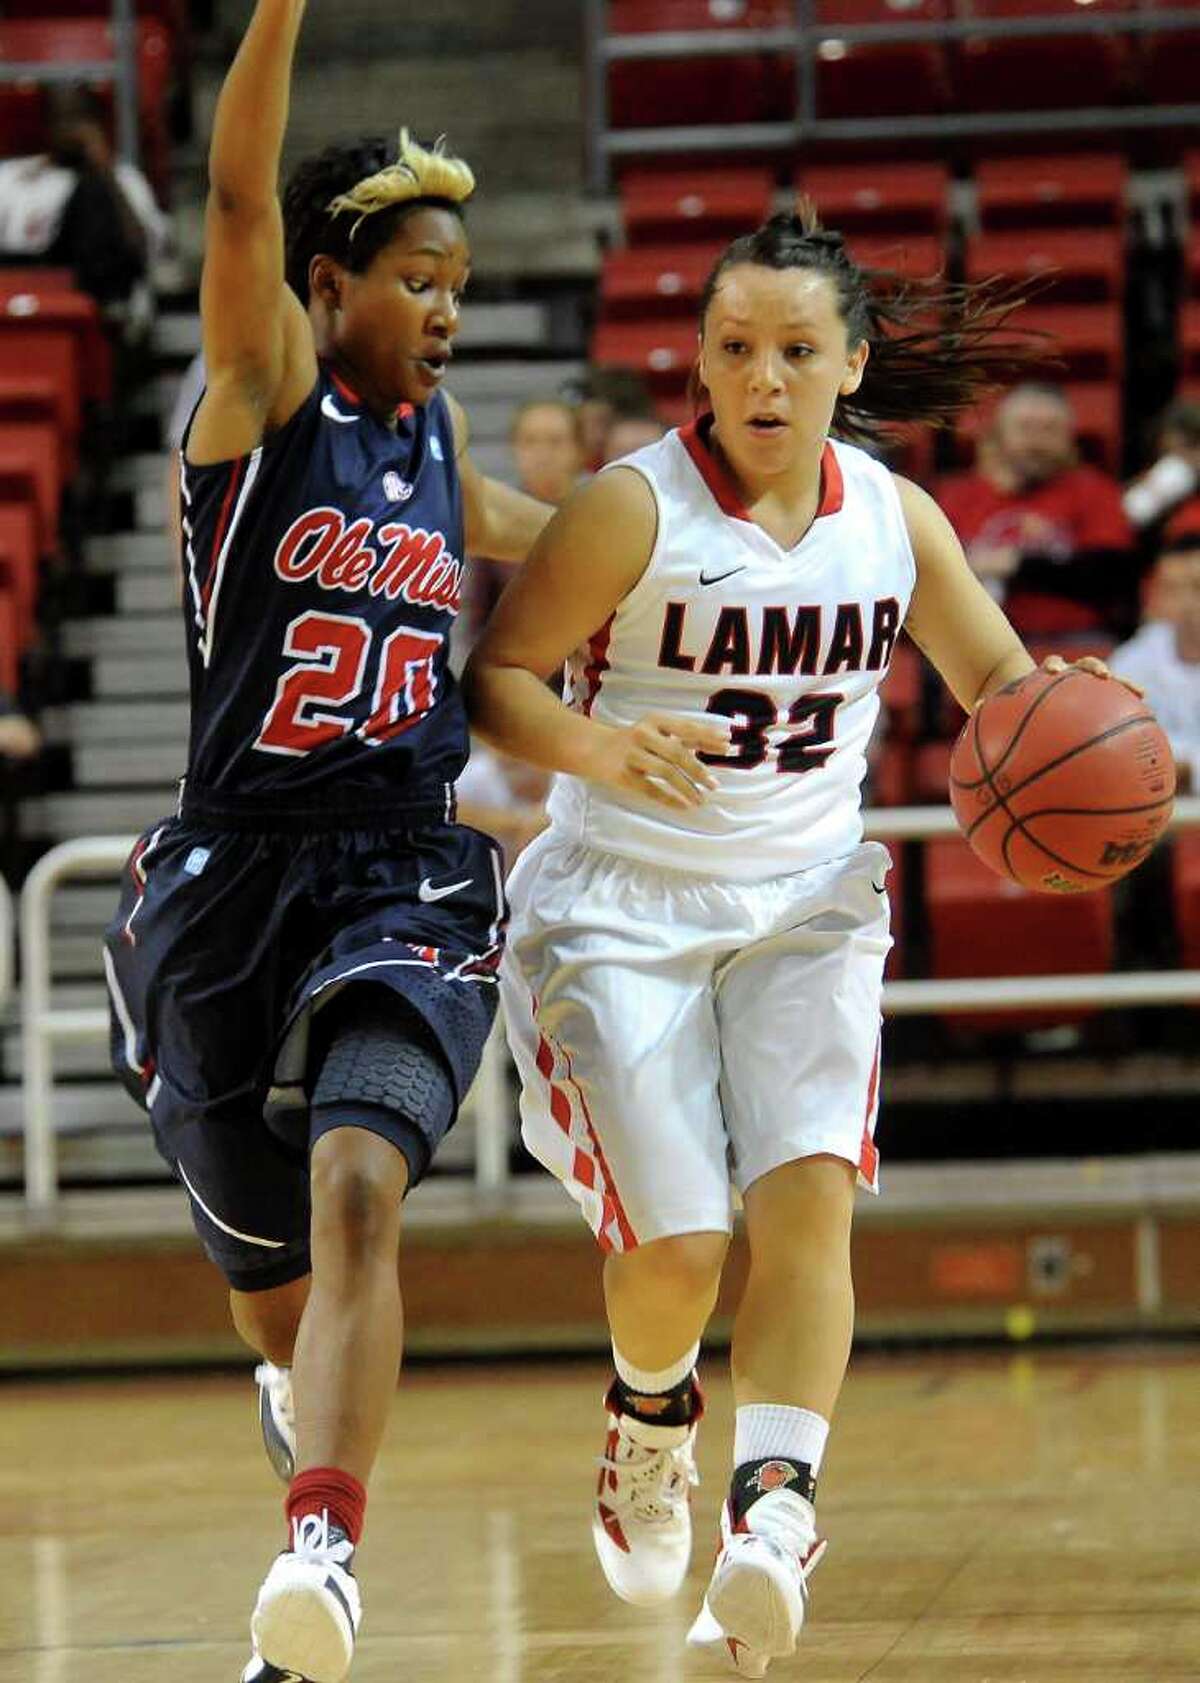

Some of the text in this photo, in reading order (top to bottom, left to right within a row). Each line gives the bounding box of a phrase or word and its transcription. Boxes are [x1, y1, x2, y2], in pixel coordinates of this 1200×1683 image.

[275, 507, 377, 592] Ole
[657, 596, 900, 676] LAMAR
[253, 609, 444, 757] 20
[694, 687, 846, 773] 32
